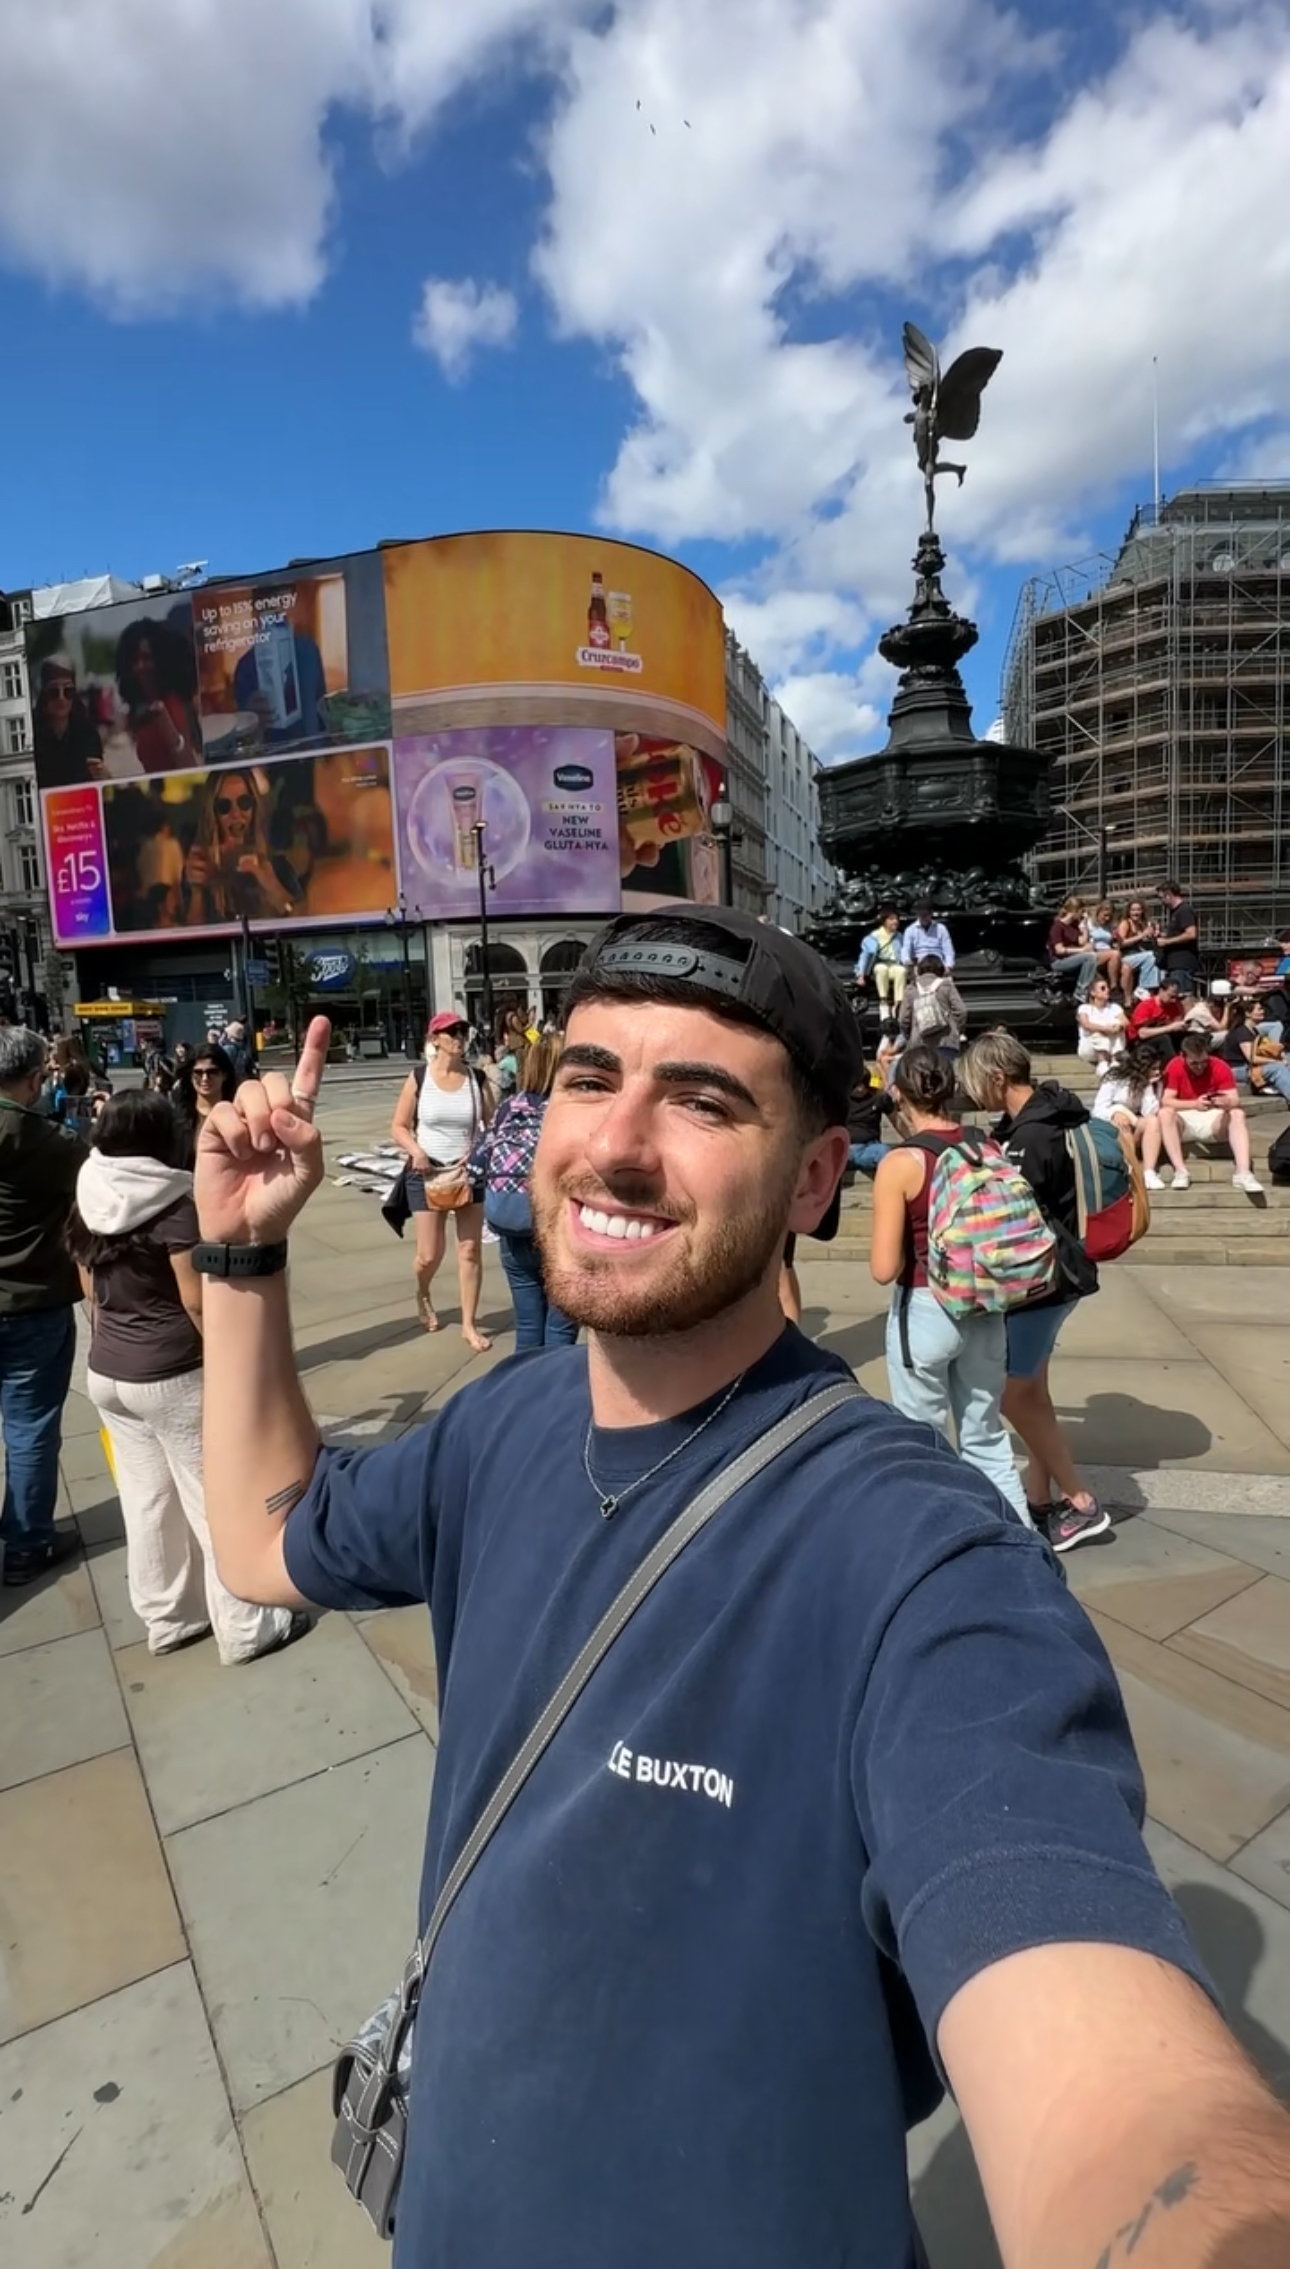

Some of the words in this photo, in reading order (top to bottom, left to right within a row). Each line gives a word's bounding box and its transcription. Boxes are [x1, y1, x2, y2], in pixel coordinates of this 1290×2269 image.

[202, 608, 217, 623] Up
[219, 605, 232, 617] to
[233, 600, 253, 614] 15%
[254, 592, 298, 611] energy
[203, 621, 241, 638] saving
[243, 617, 258, 629] on
[260, 611, 287, 631] your
[204, 631, 271, 653] refrigerator
[581, 649, 640, 669] Cruzcampo
[562, 816, 589, 825] NEW
[549, 828, 602, 838] VASELINE
[57, 850, 101, 894] £15
[75, 911, 90, 923] sky
[311, 955, 349, 982] Boots
[607, 1740, 633, 1779] LE
[636, 1755, 733, 1809] BUXTON
